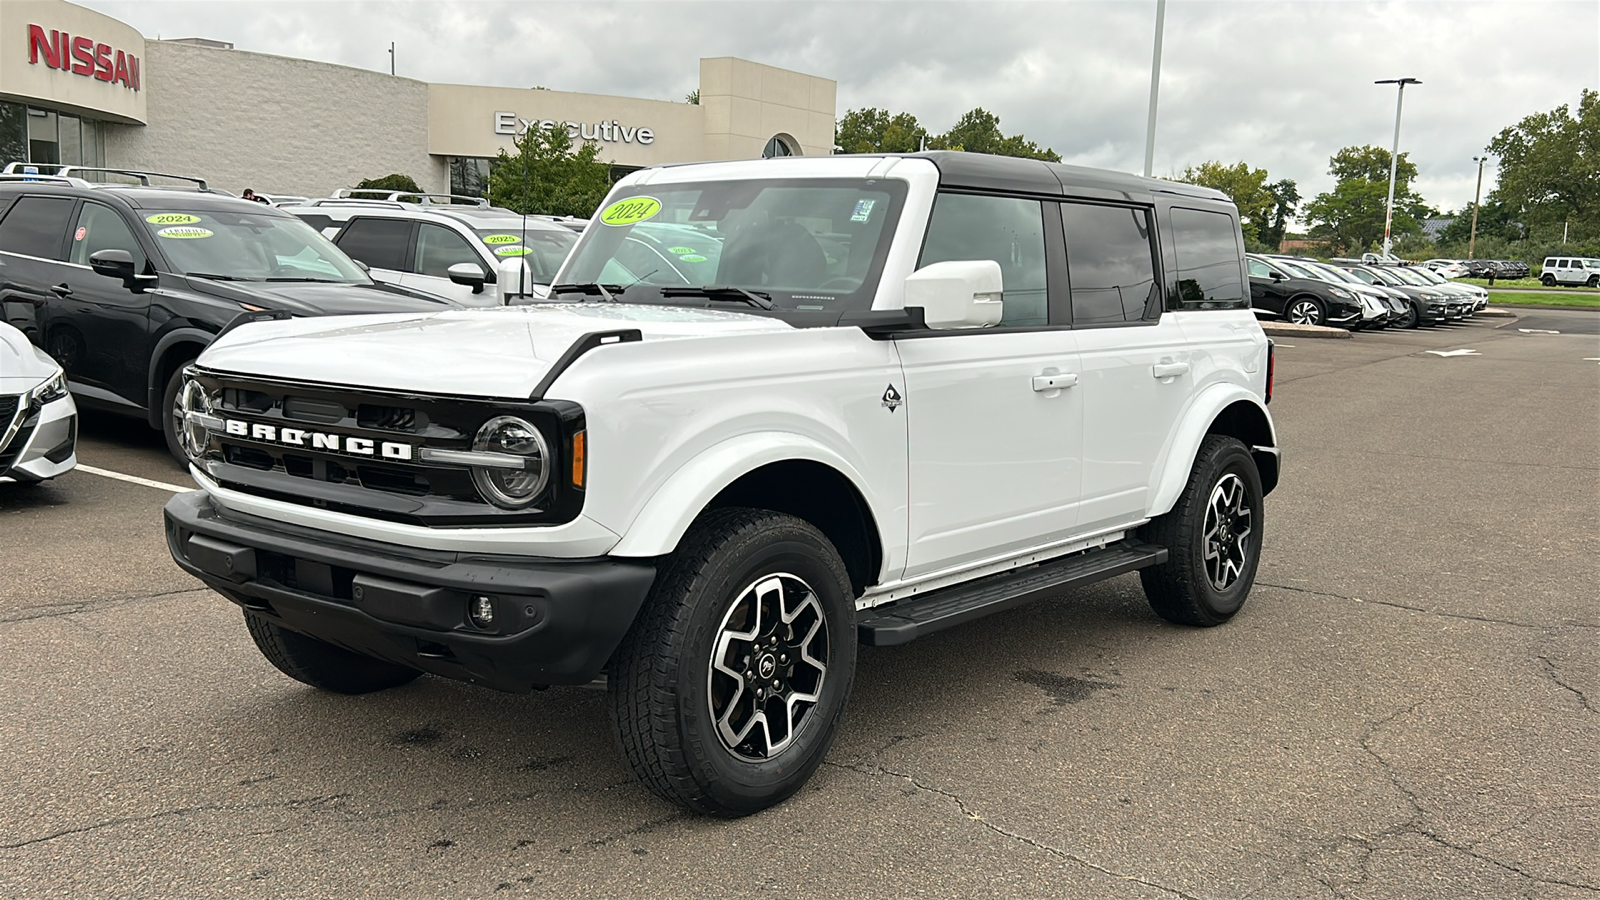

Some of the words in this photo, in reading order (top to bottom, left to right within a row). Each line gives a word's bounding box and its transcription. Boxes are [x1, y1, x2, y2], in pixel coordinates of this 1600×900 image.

[27, 23, 140, 91] NISSAN
[157, 215, 191, 223] 2024
[606, 202, 655, 221] 2024
[490, 235, 516, 243] 2025
[226, 419, 412, 460] BRONCO
